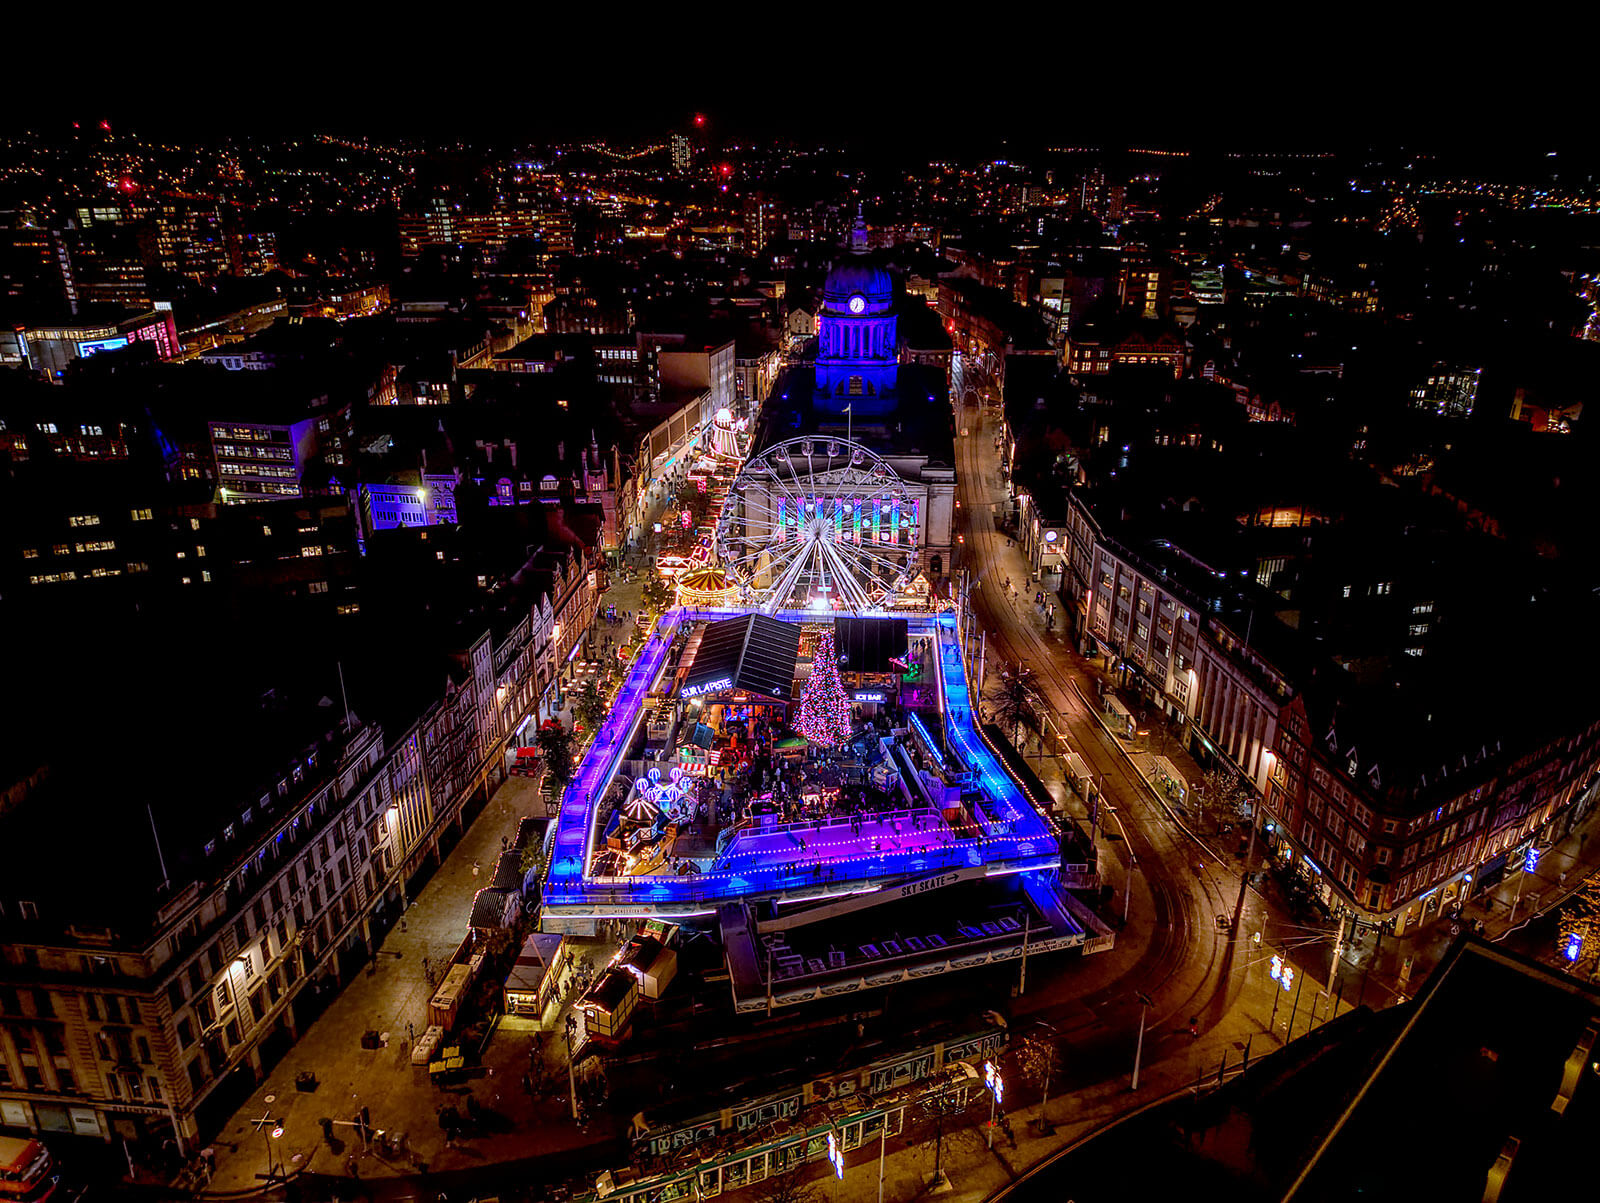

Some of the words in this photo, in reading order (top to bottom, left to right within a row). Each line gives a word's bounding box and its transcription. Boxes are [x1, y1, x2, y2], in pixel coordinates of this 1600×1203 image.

[680, 684, 699, 698] SUR
[696, 682, 711, 694] LA
[709, 677, 733, 691] PISTE
[901, 883, 917, 897] SKY
[919, 876, 945, 891] SKATE
[262, 863, 329, 936] DEBENHAMS
